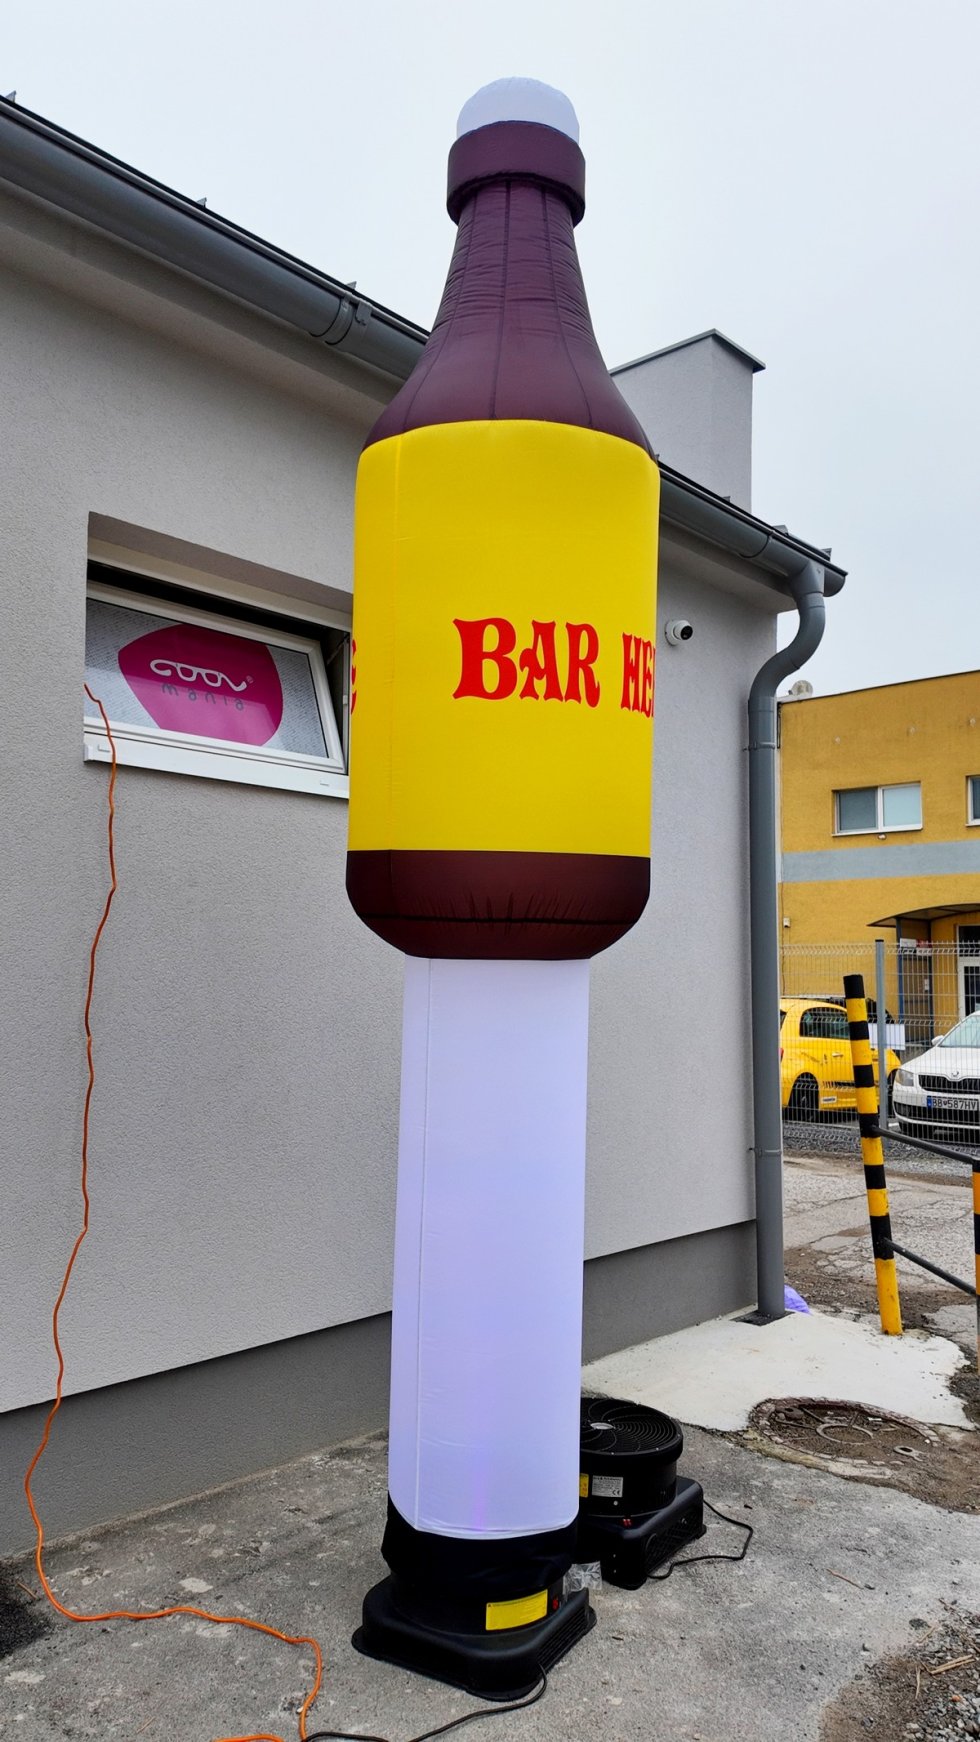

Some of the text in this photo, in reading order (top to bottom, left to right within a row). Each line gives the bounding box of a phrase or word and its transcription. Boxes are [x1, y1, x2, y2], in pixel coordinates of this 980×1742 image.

[160, 682, 245, 711] mania
[452, 617, 601, 708] BAR
[620, 632, 656, 719] HE
